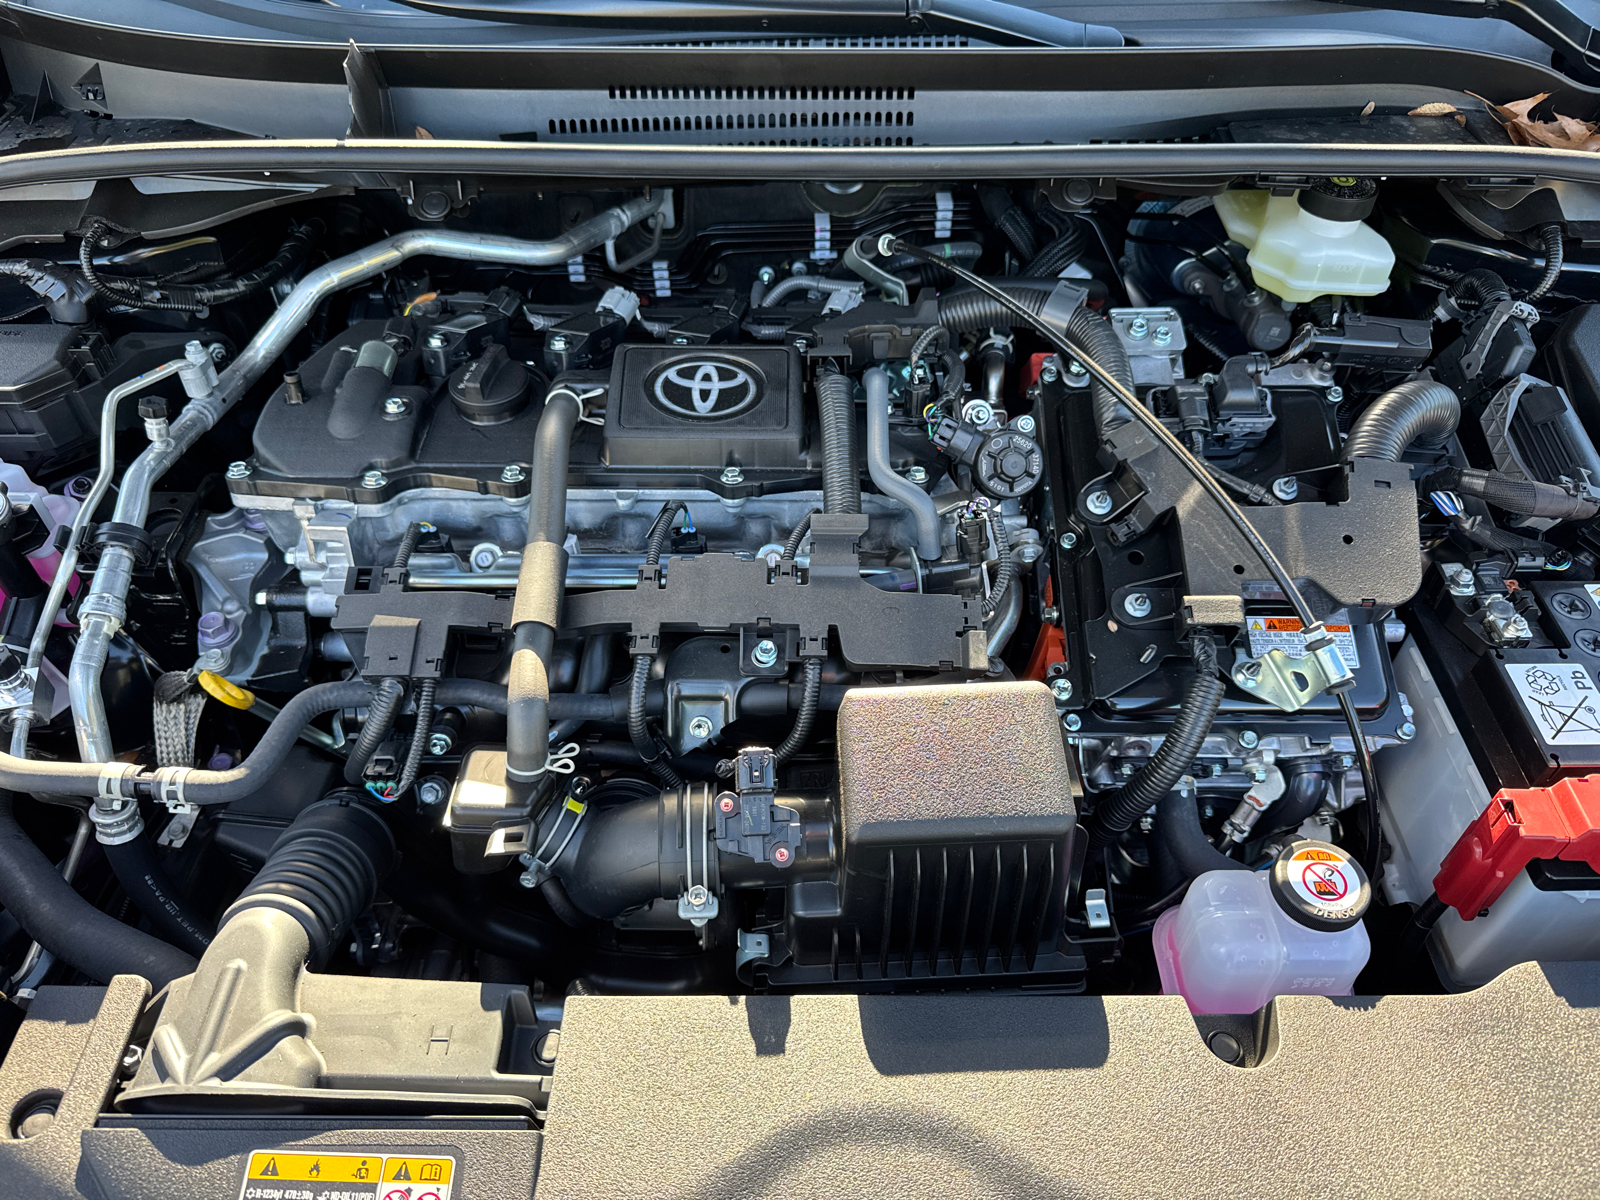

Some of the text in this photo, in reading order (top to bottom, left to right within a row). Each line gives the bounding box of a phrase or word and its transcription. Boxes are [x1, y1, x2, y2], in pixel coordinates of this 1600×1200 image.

[1012, 435, 1033, 449] 25620
[1032, 453, 1040, 474] 37140
[1571, 670, 1593, 690] Pb
[1313, 906, 1357, 920] DENSO
